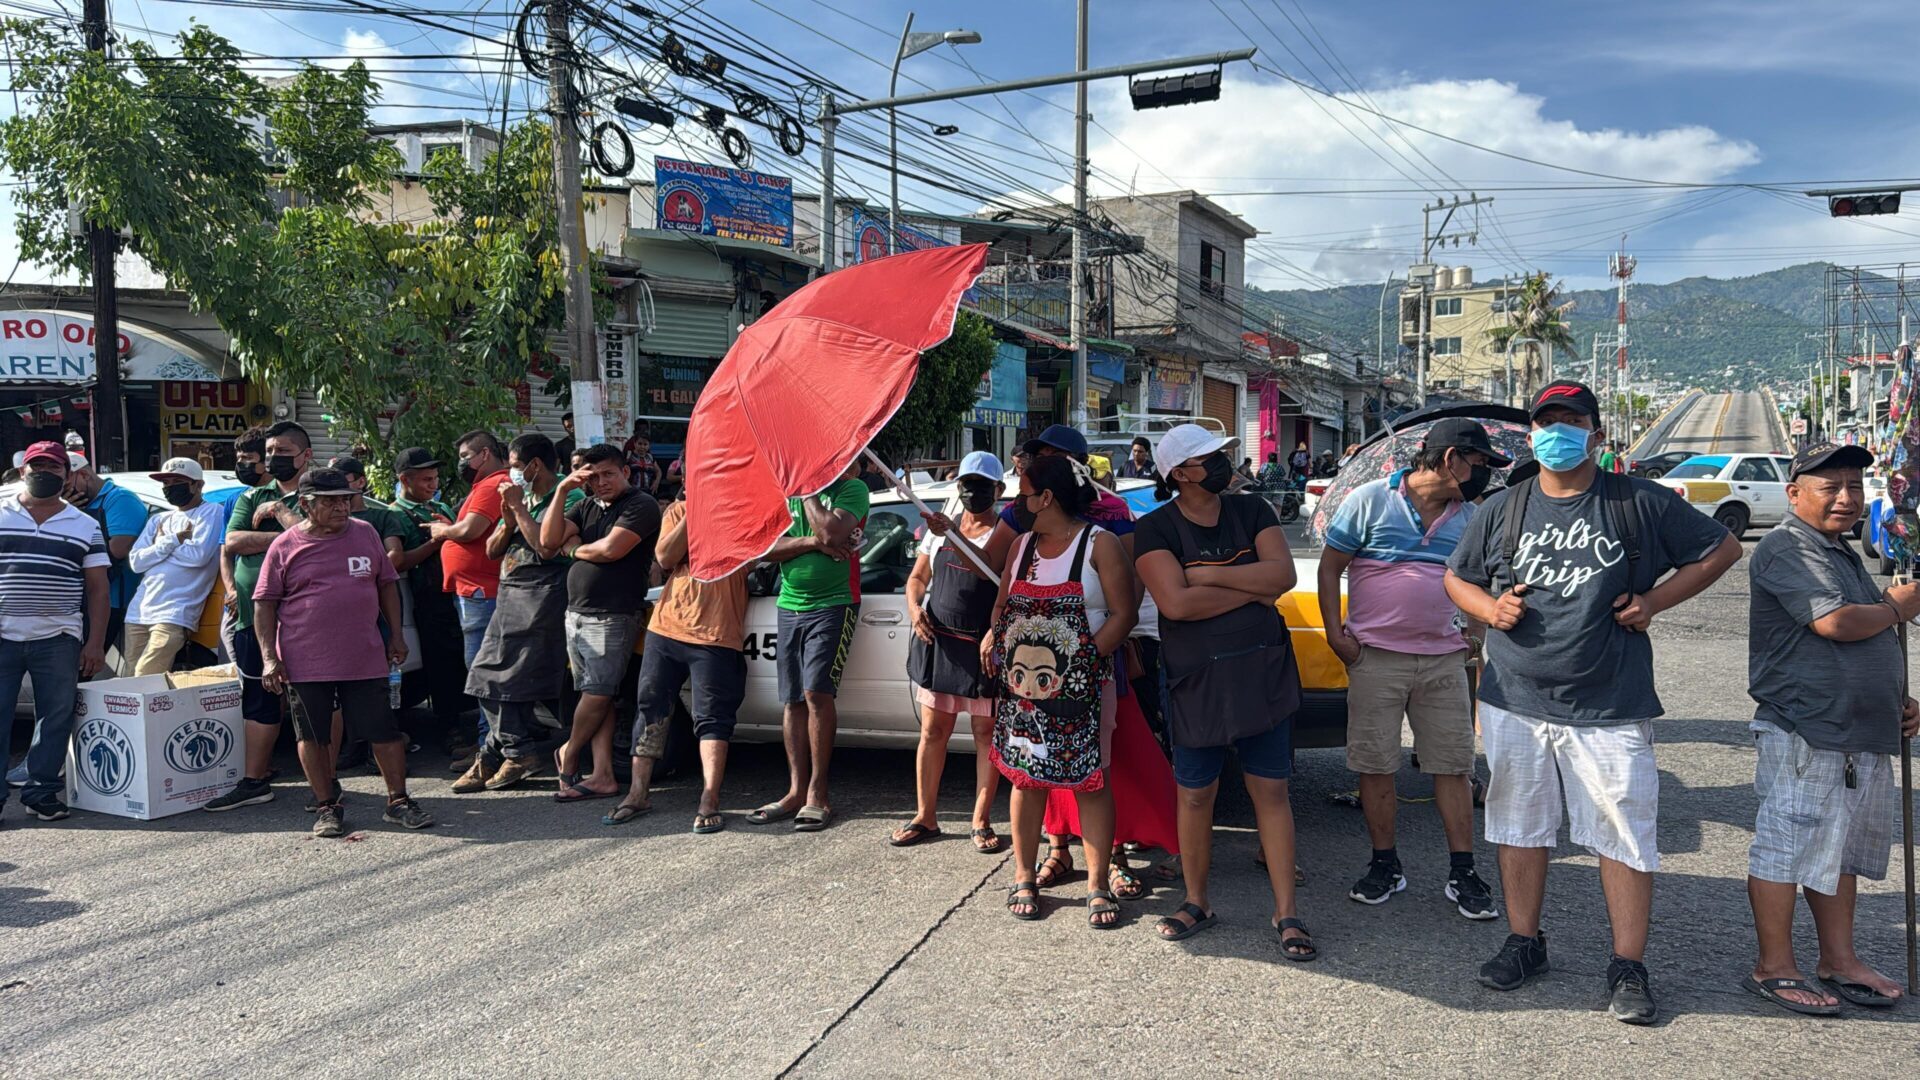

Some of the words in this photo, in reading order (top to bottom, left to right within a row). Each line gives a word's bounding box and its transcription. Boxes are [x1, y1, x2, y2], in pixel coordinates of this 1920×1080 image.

[2, 319, 47, 340] RO
[0, 352, 96, 376] REN'
[663, 367, 700, 381] CANINA
[165, 381, 245, 408] ORO
[670, 390, 699, 404] GAL
[175, 413, 248, 430] PLATA
[1513, 518, 1601, 569] girls
[1525, 553, 1602, 598] trip
[82, 721, 126, 753] REYMA
[174, 720, 224, 745] REYMA
